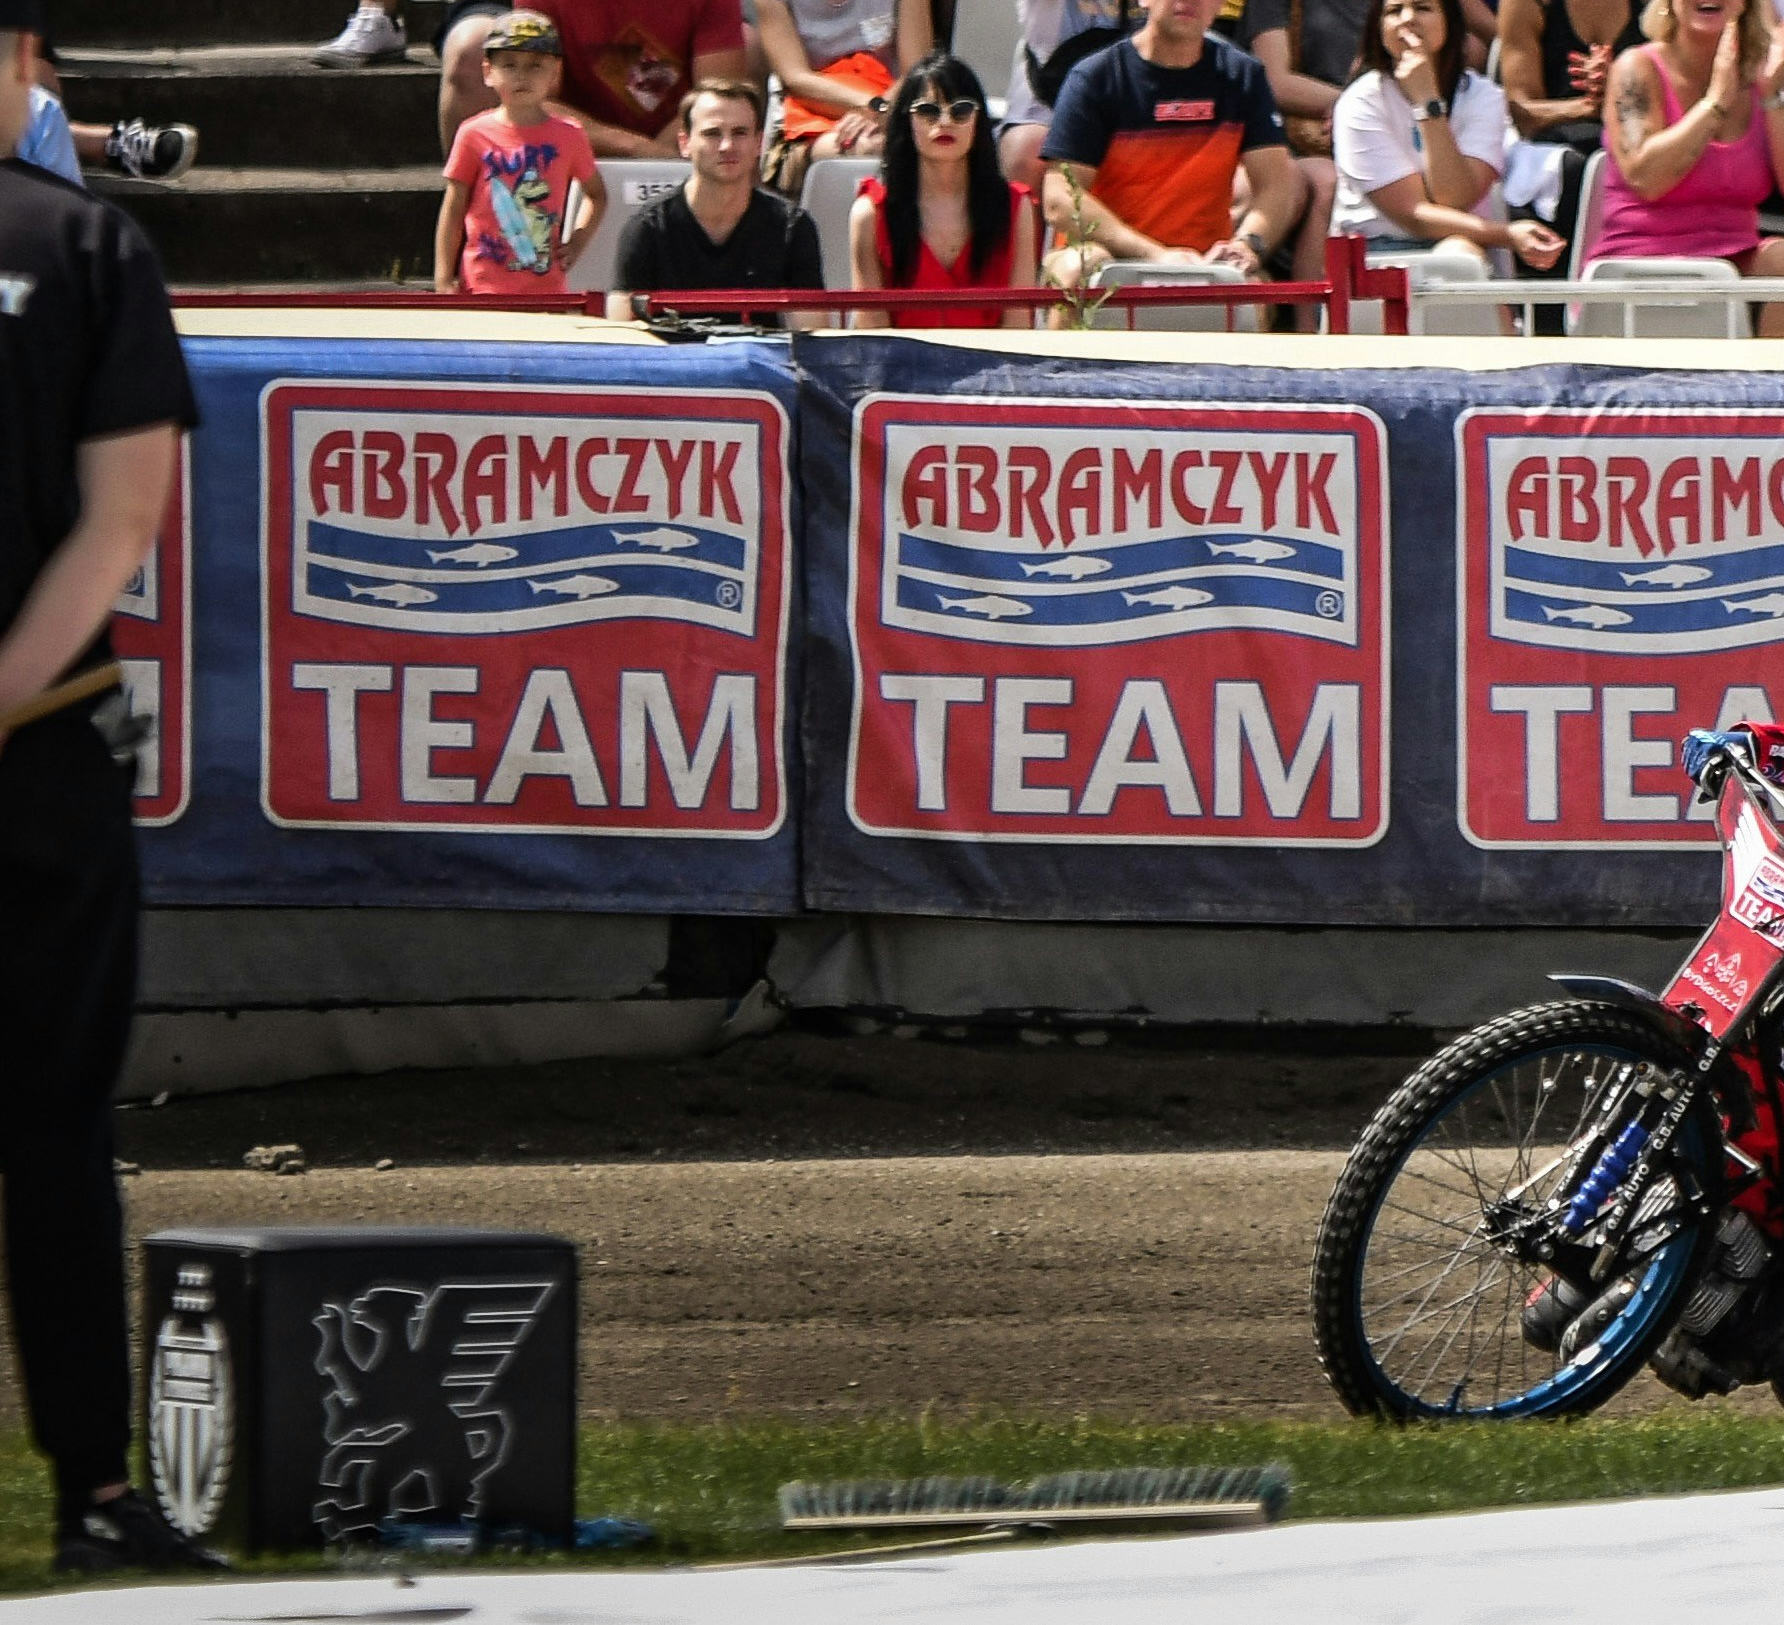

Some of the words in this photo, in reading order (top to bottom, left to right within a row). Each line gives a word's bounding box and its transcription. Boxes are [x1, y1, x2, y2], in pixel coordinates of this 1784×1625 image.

[482, 144, 559, 178] SURF
[309, 429, 743, 536] ABRAMCZYK
[902, 444, 1340, 548] ABRAMCZYK
[291, 663, 759, 811] TEAM
[880, 675, 1361, 819] TEAM
